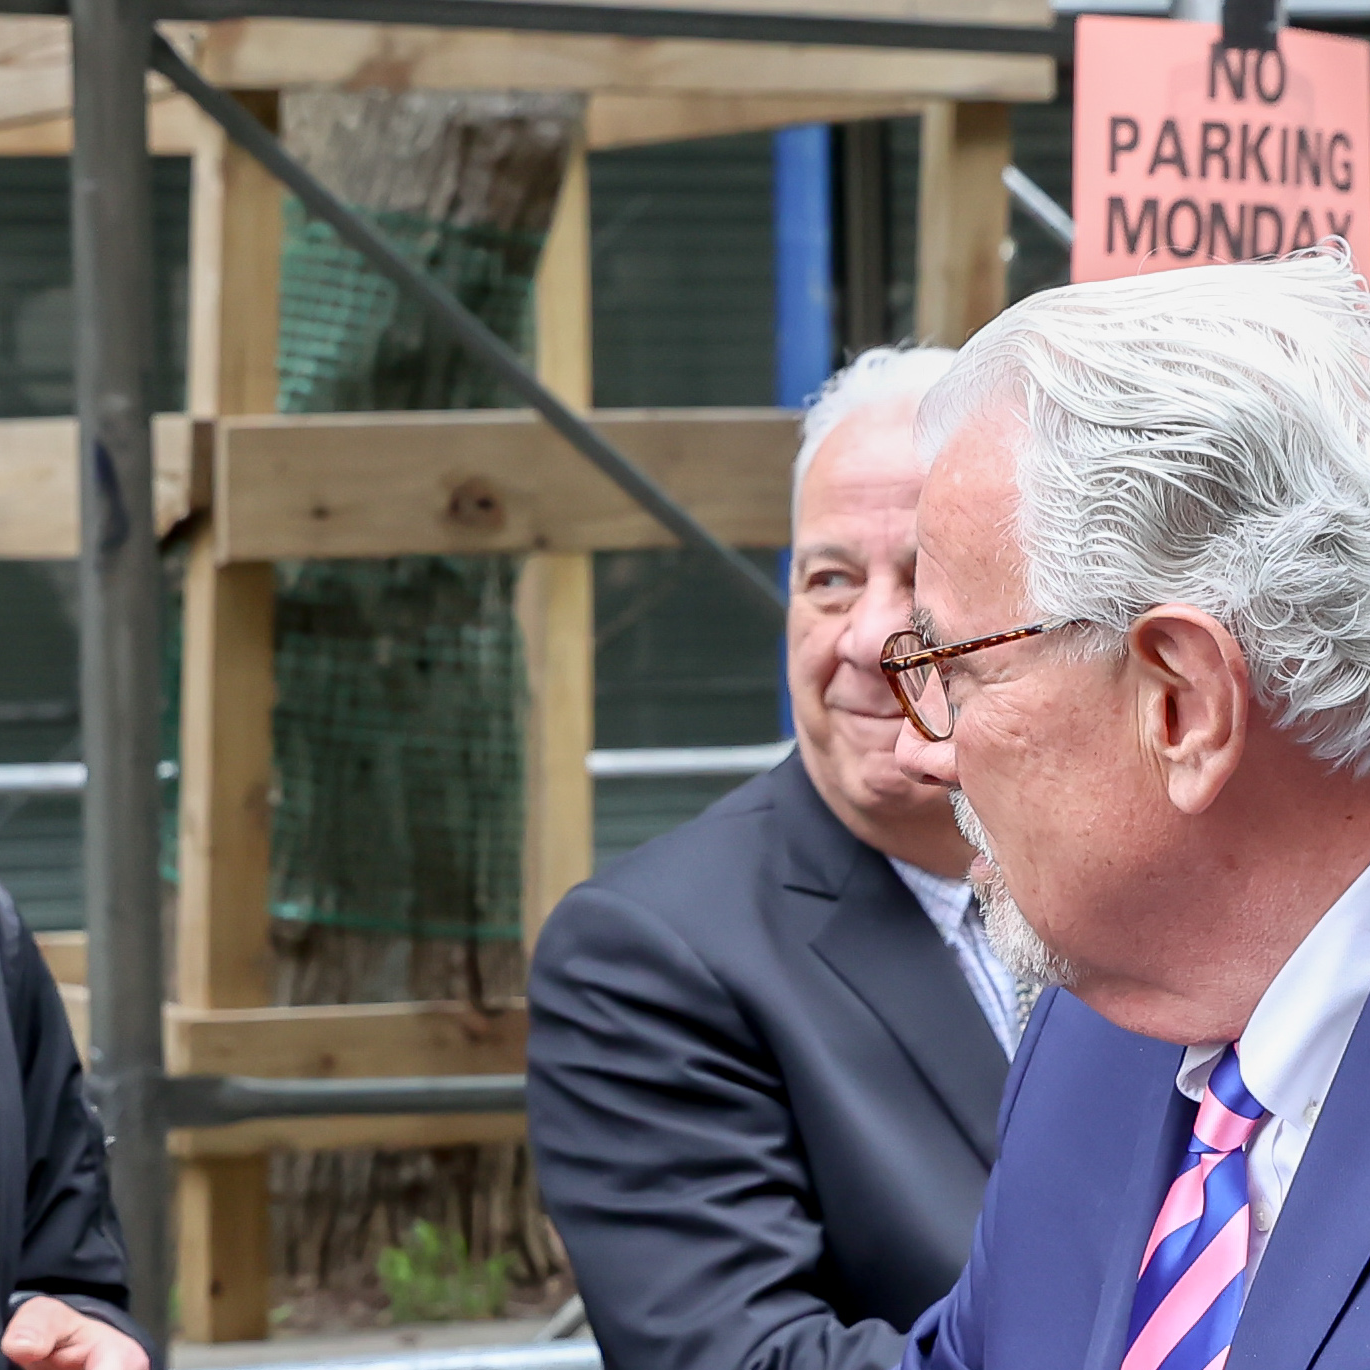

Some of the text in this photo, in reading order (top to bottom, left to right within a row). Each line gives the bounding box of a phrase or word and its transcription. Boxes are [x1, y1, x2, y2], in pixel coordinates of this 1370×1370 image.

[1207, 42, 1285, 105] NO
[1108, 116, 1353, 191] PARKING
[1107, 196, 1352, 260] MONDAY
